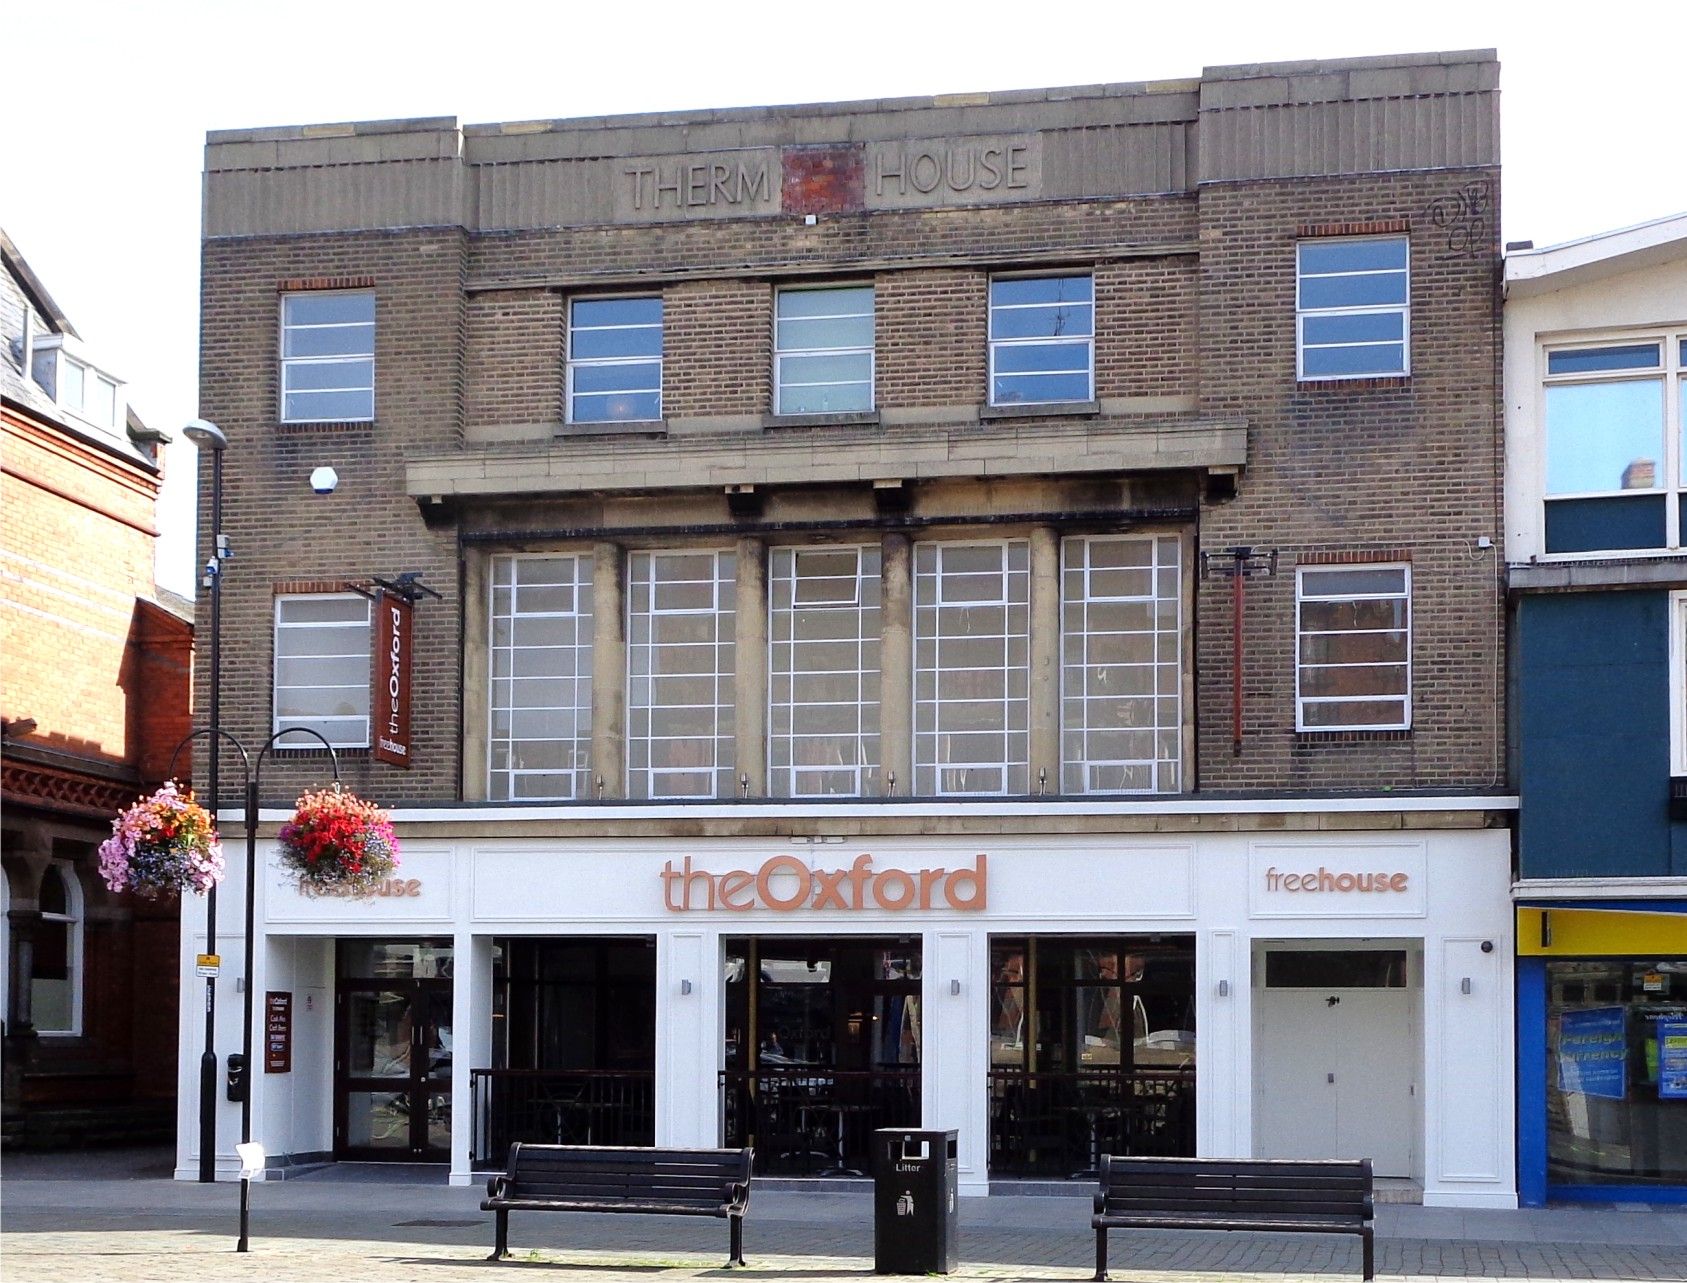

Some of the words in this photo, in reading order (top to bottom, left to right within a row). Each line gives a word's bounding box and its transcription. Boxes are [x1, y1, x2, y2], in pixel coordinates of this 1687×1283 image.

[625, 160, 770, 210] THERM
[874, 144, 1028, 196] HOUSE
[388, 606, 400, 735] theOxford
[659, 853, 987, 912] theOxford
[1265, 866, 1410, 892] freehouse
[895, 1163, 921, 1172] Litter
